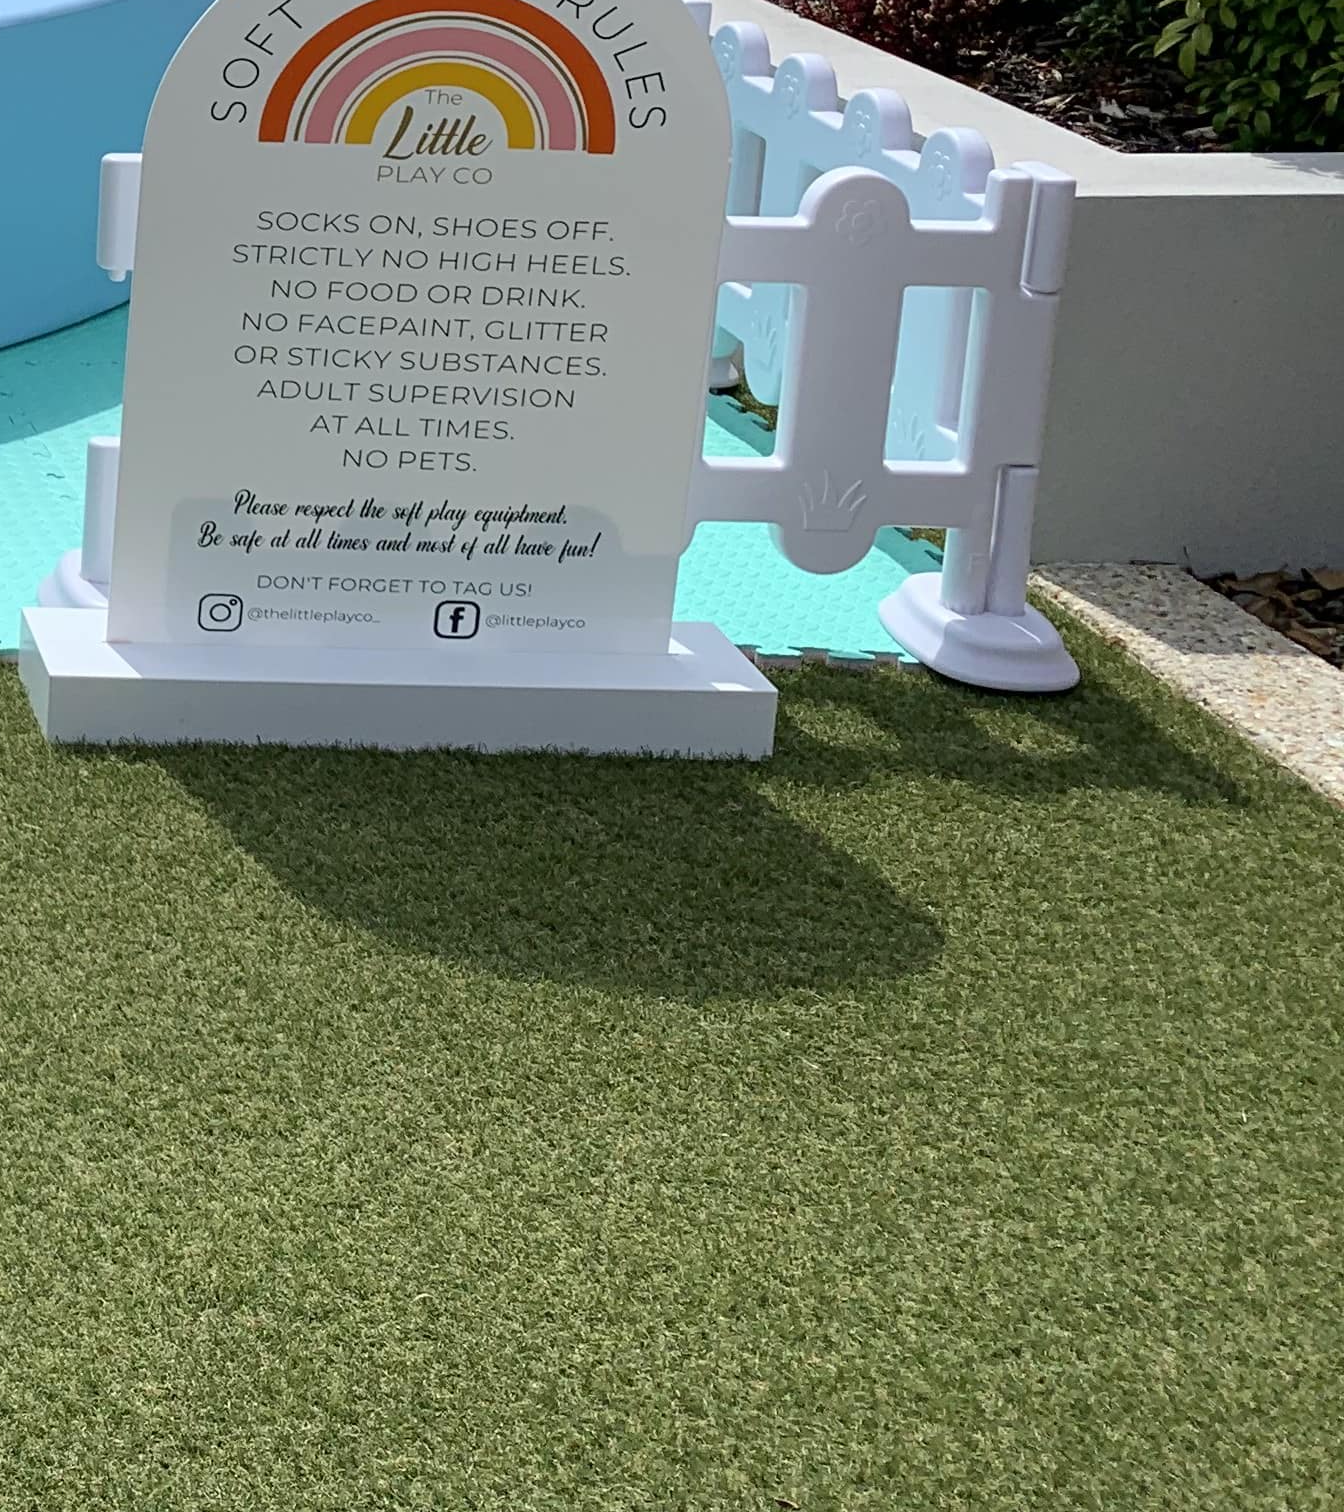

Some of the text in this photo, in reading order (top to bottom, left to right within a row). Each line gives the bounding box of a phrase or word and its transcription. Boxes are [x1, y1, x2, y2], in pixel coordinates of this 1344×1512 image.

[425, 89, 463, 106] The
[382, 105, 494, 161] Little
[376, 164, 493, 185] PLAY CO
[256, 210, 614, 242] SOCKS ON, SHOES OFF.
[232, 243, 631, 277] STRICTLY NO HIGH HEELS.
[271, 279, 586, 309] NO FOOD OR DRINK.
[242, 311, 608, 343] NO FACEPAINT, GLITTER
[234, 344, 607, 377] OR STICKY SUBSTANCES.
[256, 379, 575, 409] ADULT SUPERVISION
[309, 414, 515, 441] AT ALL TIMES.
[342, 448, 477, 472] NO PETS.
[233, 488, 568, 533] Please respect the soft play equiptment.
[196, 520, 602, 565] Be safe at all times and most of all have fun!
[256, 574, 533, 598] DON'T FORGET TO TAG US!
[484, 614, 587, 631] @littleplayco
